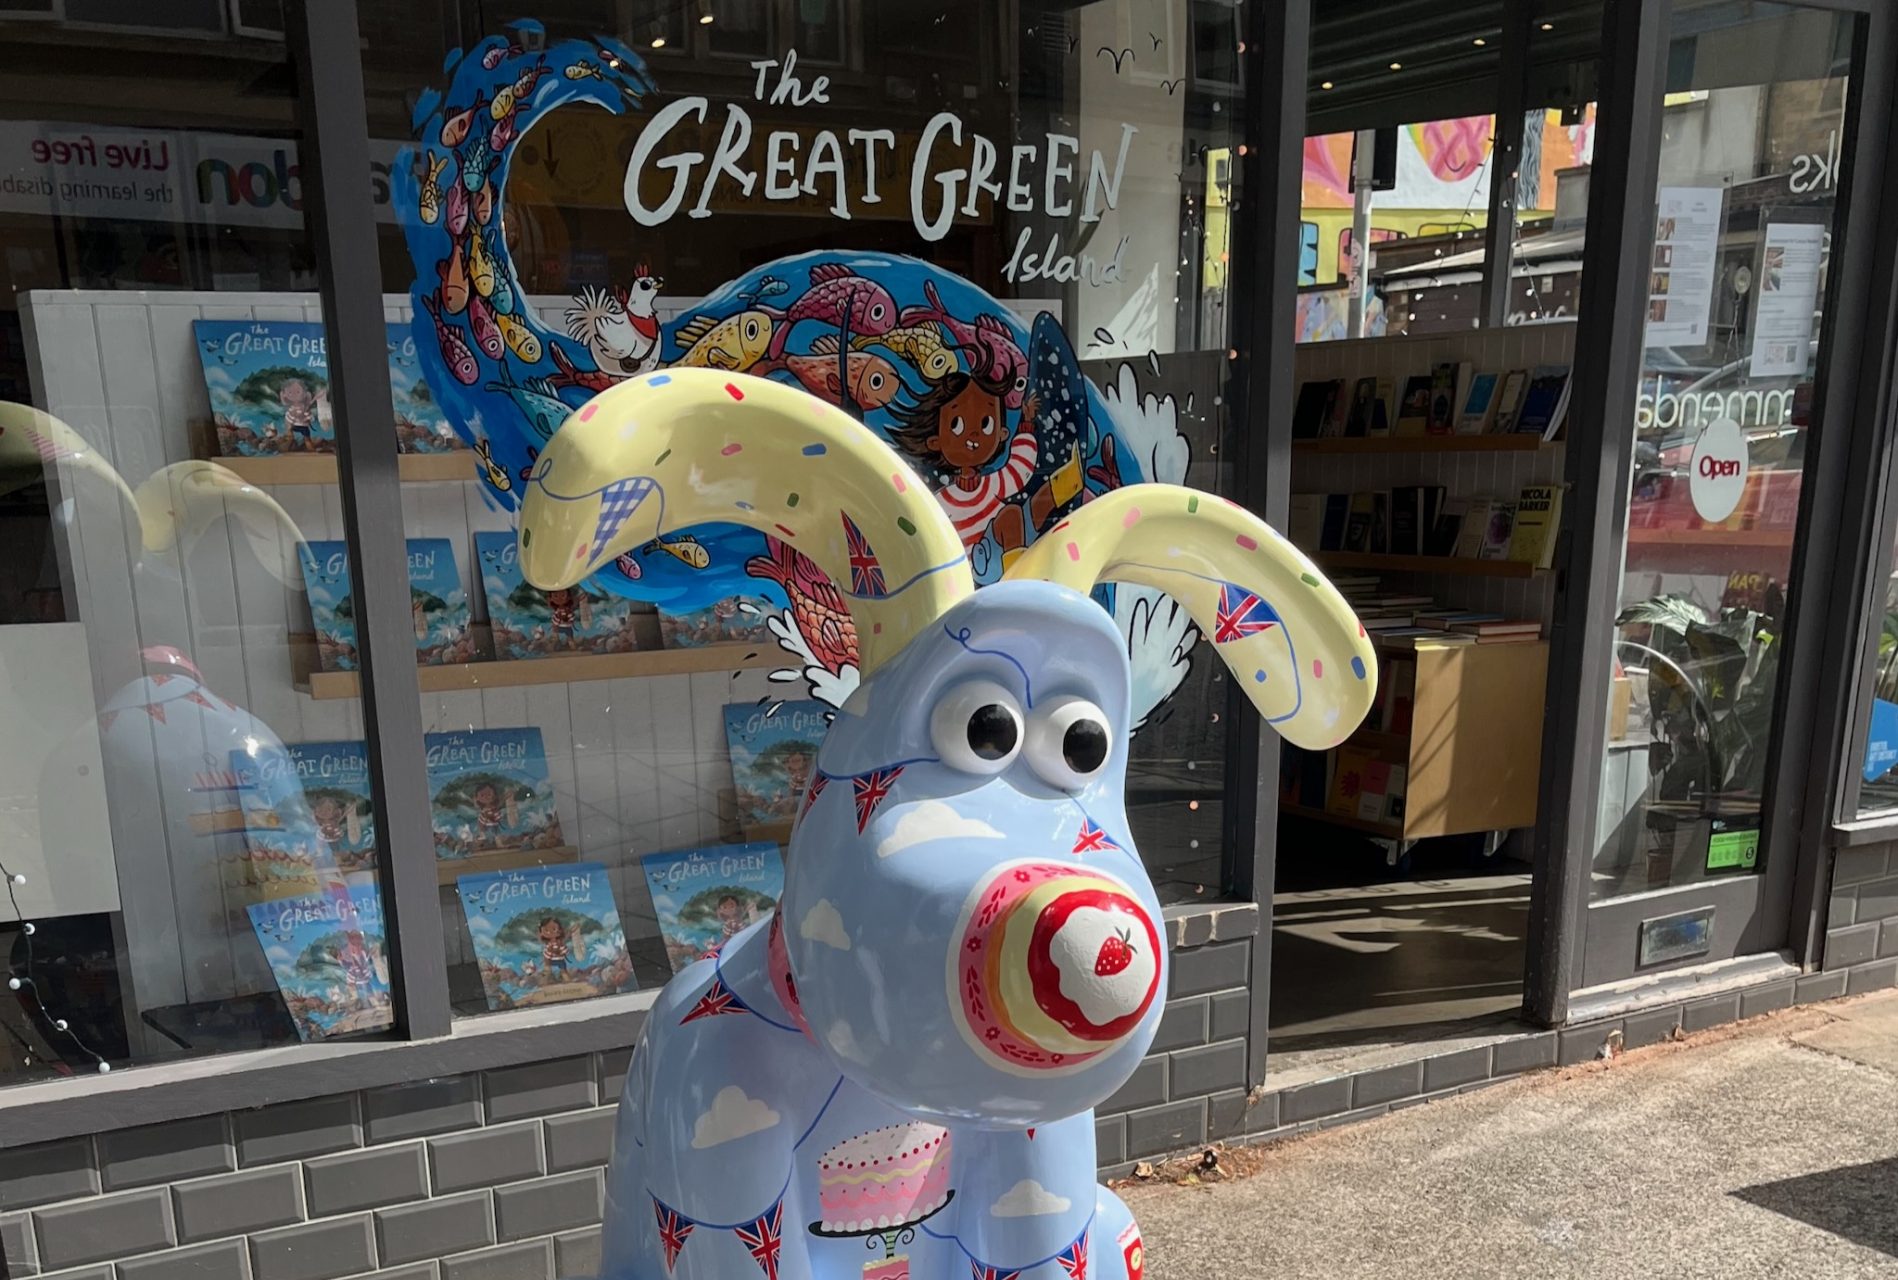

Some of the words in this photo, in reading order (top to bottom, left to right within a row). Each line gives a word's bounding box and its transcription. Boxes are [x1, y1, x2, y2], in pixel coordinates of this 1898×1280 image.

[750, 48, 830, 107] The
[622, 96, 895, 227] GREAT
[911, 112, 1139, 241] GREEN
[1001, 227, 1131, 285] Island
[250, 324, 269, 335] The
[224, 332, 284, 356] GREAT
[288, 333, 326, 358] GREE
[1699, 455, 1740, 480] Open
[1518, 501, 1551, 512] BARKER
[1521, 489, 1552, 500] NICOLA
[746, 712, 791, 734] GREAT
[792, 710, 825, 732] GREE
[447, 735, 465, 746] The
[426, 745, 477, 767] GREAT
[481, 740, 527, 763] GREEN
[260, 758, 317, 781] GREAT
[320, 754, 368, 777] GREEN
[668, 860, 717, 883] GREAT
[720, 852, 765, 877] GREEN
[688, 852, 704, 862] The
[485, 881, 539, 904] GREAT
[543, 873, 591, 898] GREEN
[508, 872, 525, 883] The
[561, 892, 592, 904] Island
[279, 905, 332, 932] GREAT
